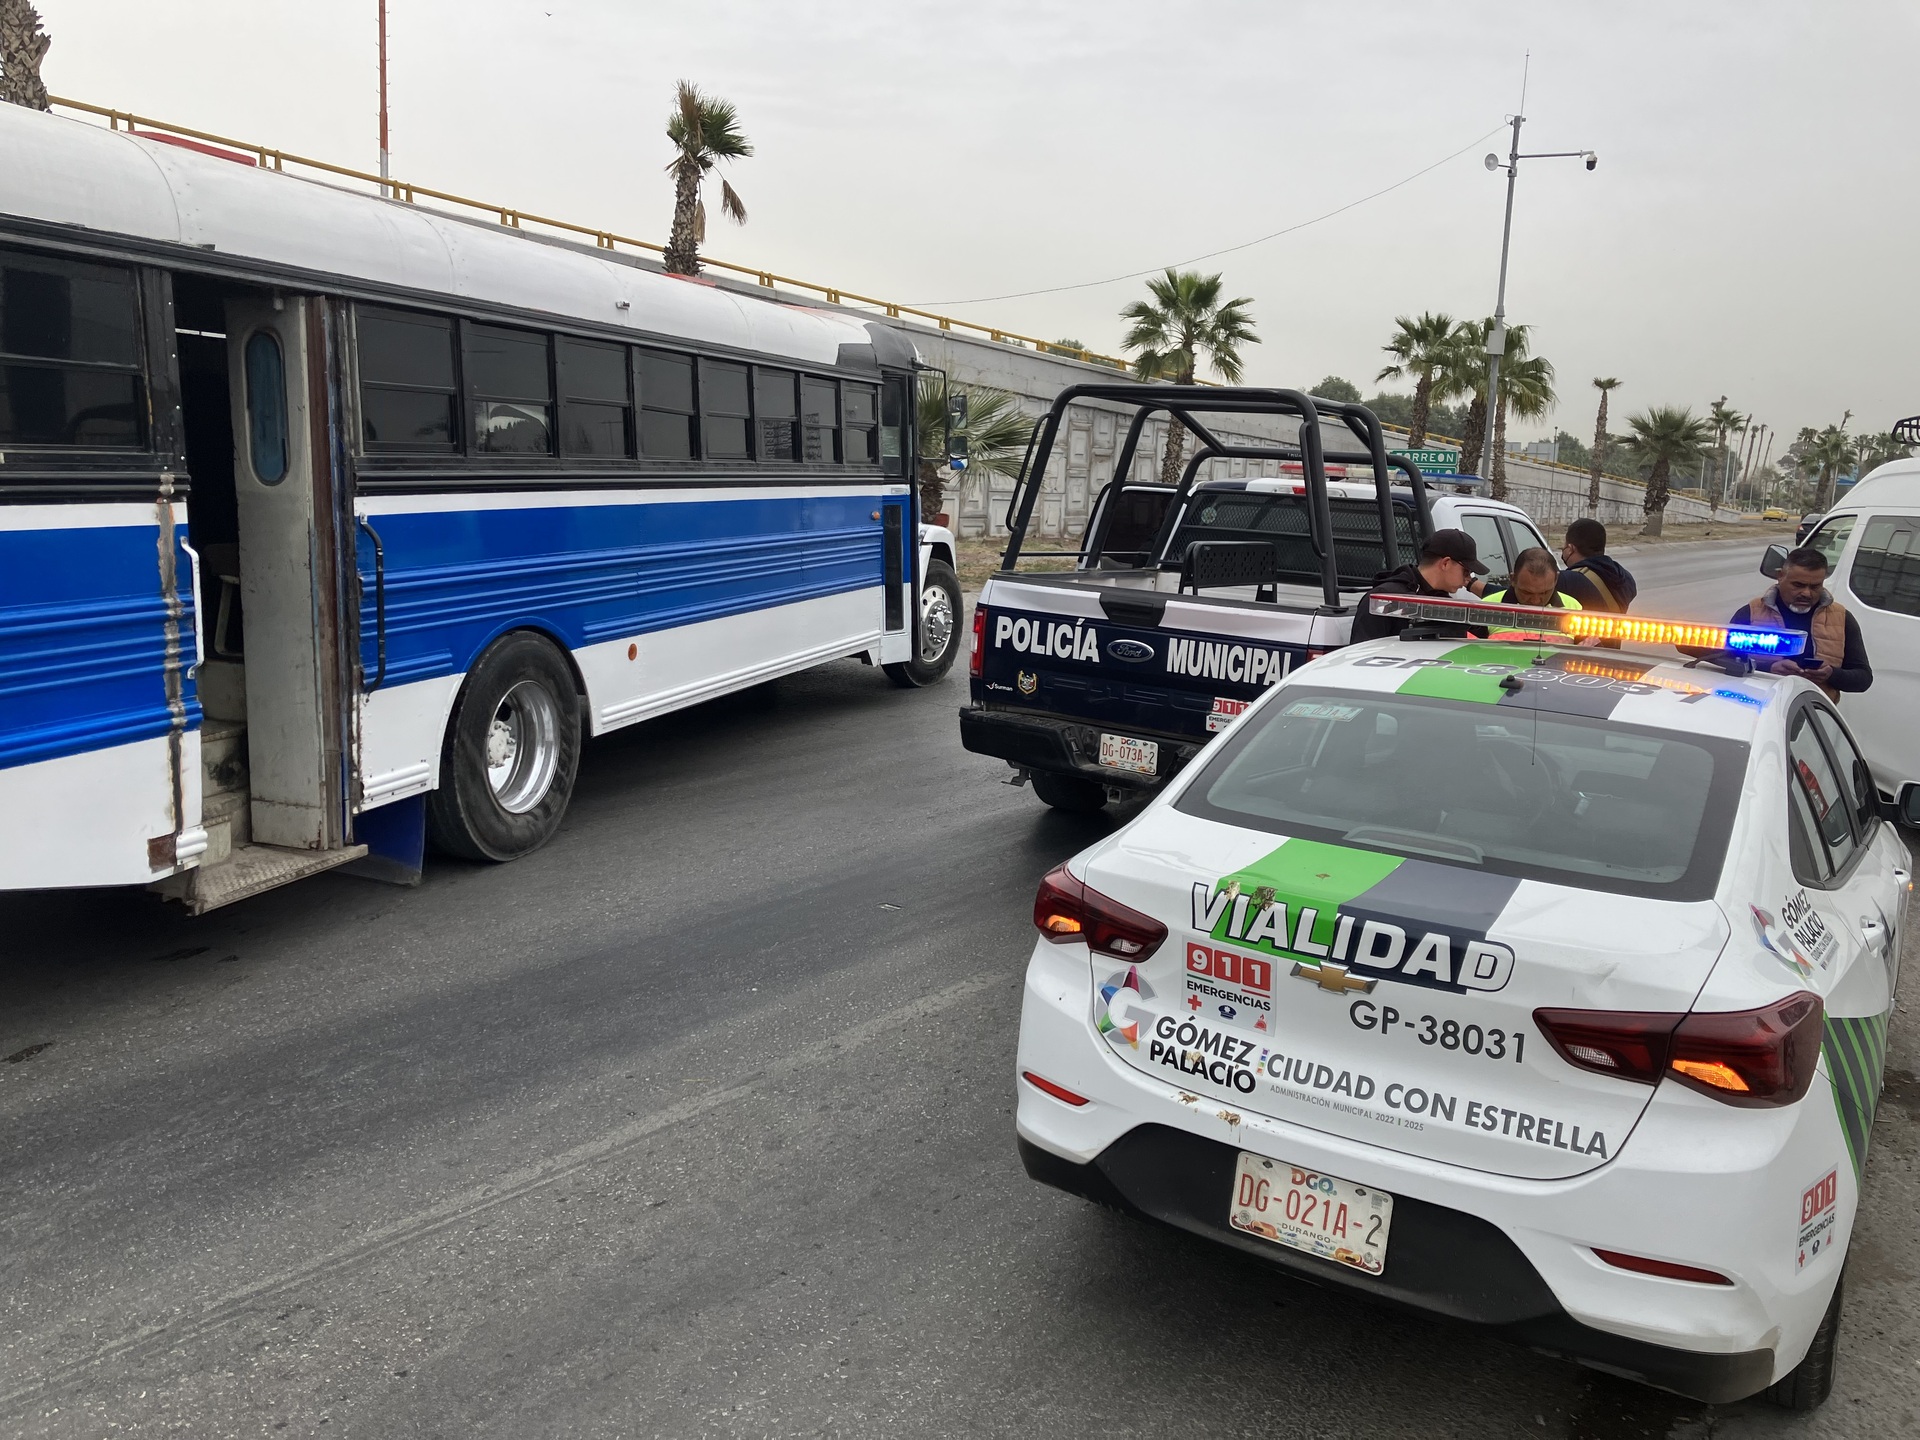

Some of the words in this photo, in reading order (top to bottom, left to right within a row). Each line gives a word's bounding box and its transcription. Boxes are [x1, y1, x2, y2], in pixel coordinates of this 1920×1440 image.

[1396, 452, 1454, 462] ORREON
[995, 615, 1100, 663] POLICÍA
[1116, 643, 1143, 658] Ford
[1166, 637, 1291, 686] MUNICIPAL
[1208, 716, 1233, 724] EMERGE
[1102, 742, 1154, 765] DG-073A-2
[1782, 888, 1812, 929] GÓMEZ
[1191, 882, 1516, 993] VIALIDAD
[1794, 910, 1825, 952] PALACIO
[1192, 949, 1262, 985] 911
[1186, 980, 1271, 1012] EMERGENCIAS
[1156, 1015, 1256, 1066] GÓMEZ
[1349, 999, 1526, 1064] GP-38031
[1150, 1039, 1256, 1094] PALACIO
[1267, 1053, 1376, 1100] CIUDAD
[1384, 1083, 1457, 1122] CON
[1465, 1102, 1609, 1160] ESTRELLA
[1270, 1084, 1331, 1109] ADMINISTRACIÓN
[1332, 1103, 1373, 1120] MUNICIPAL
[1375, 1112, 1395, 1125] 2022
[1404, 1119, 1425, 1132] 2025
[1238, 1173, 1383, 1248] DG-021A-2
[1804, 1177, 1833, 1220] 911
[1281, 1222, 1331, 1244] DURANGO
[1799, 1213, 1835, 1248] EMERGENCIAS
